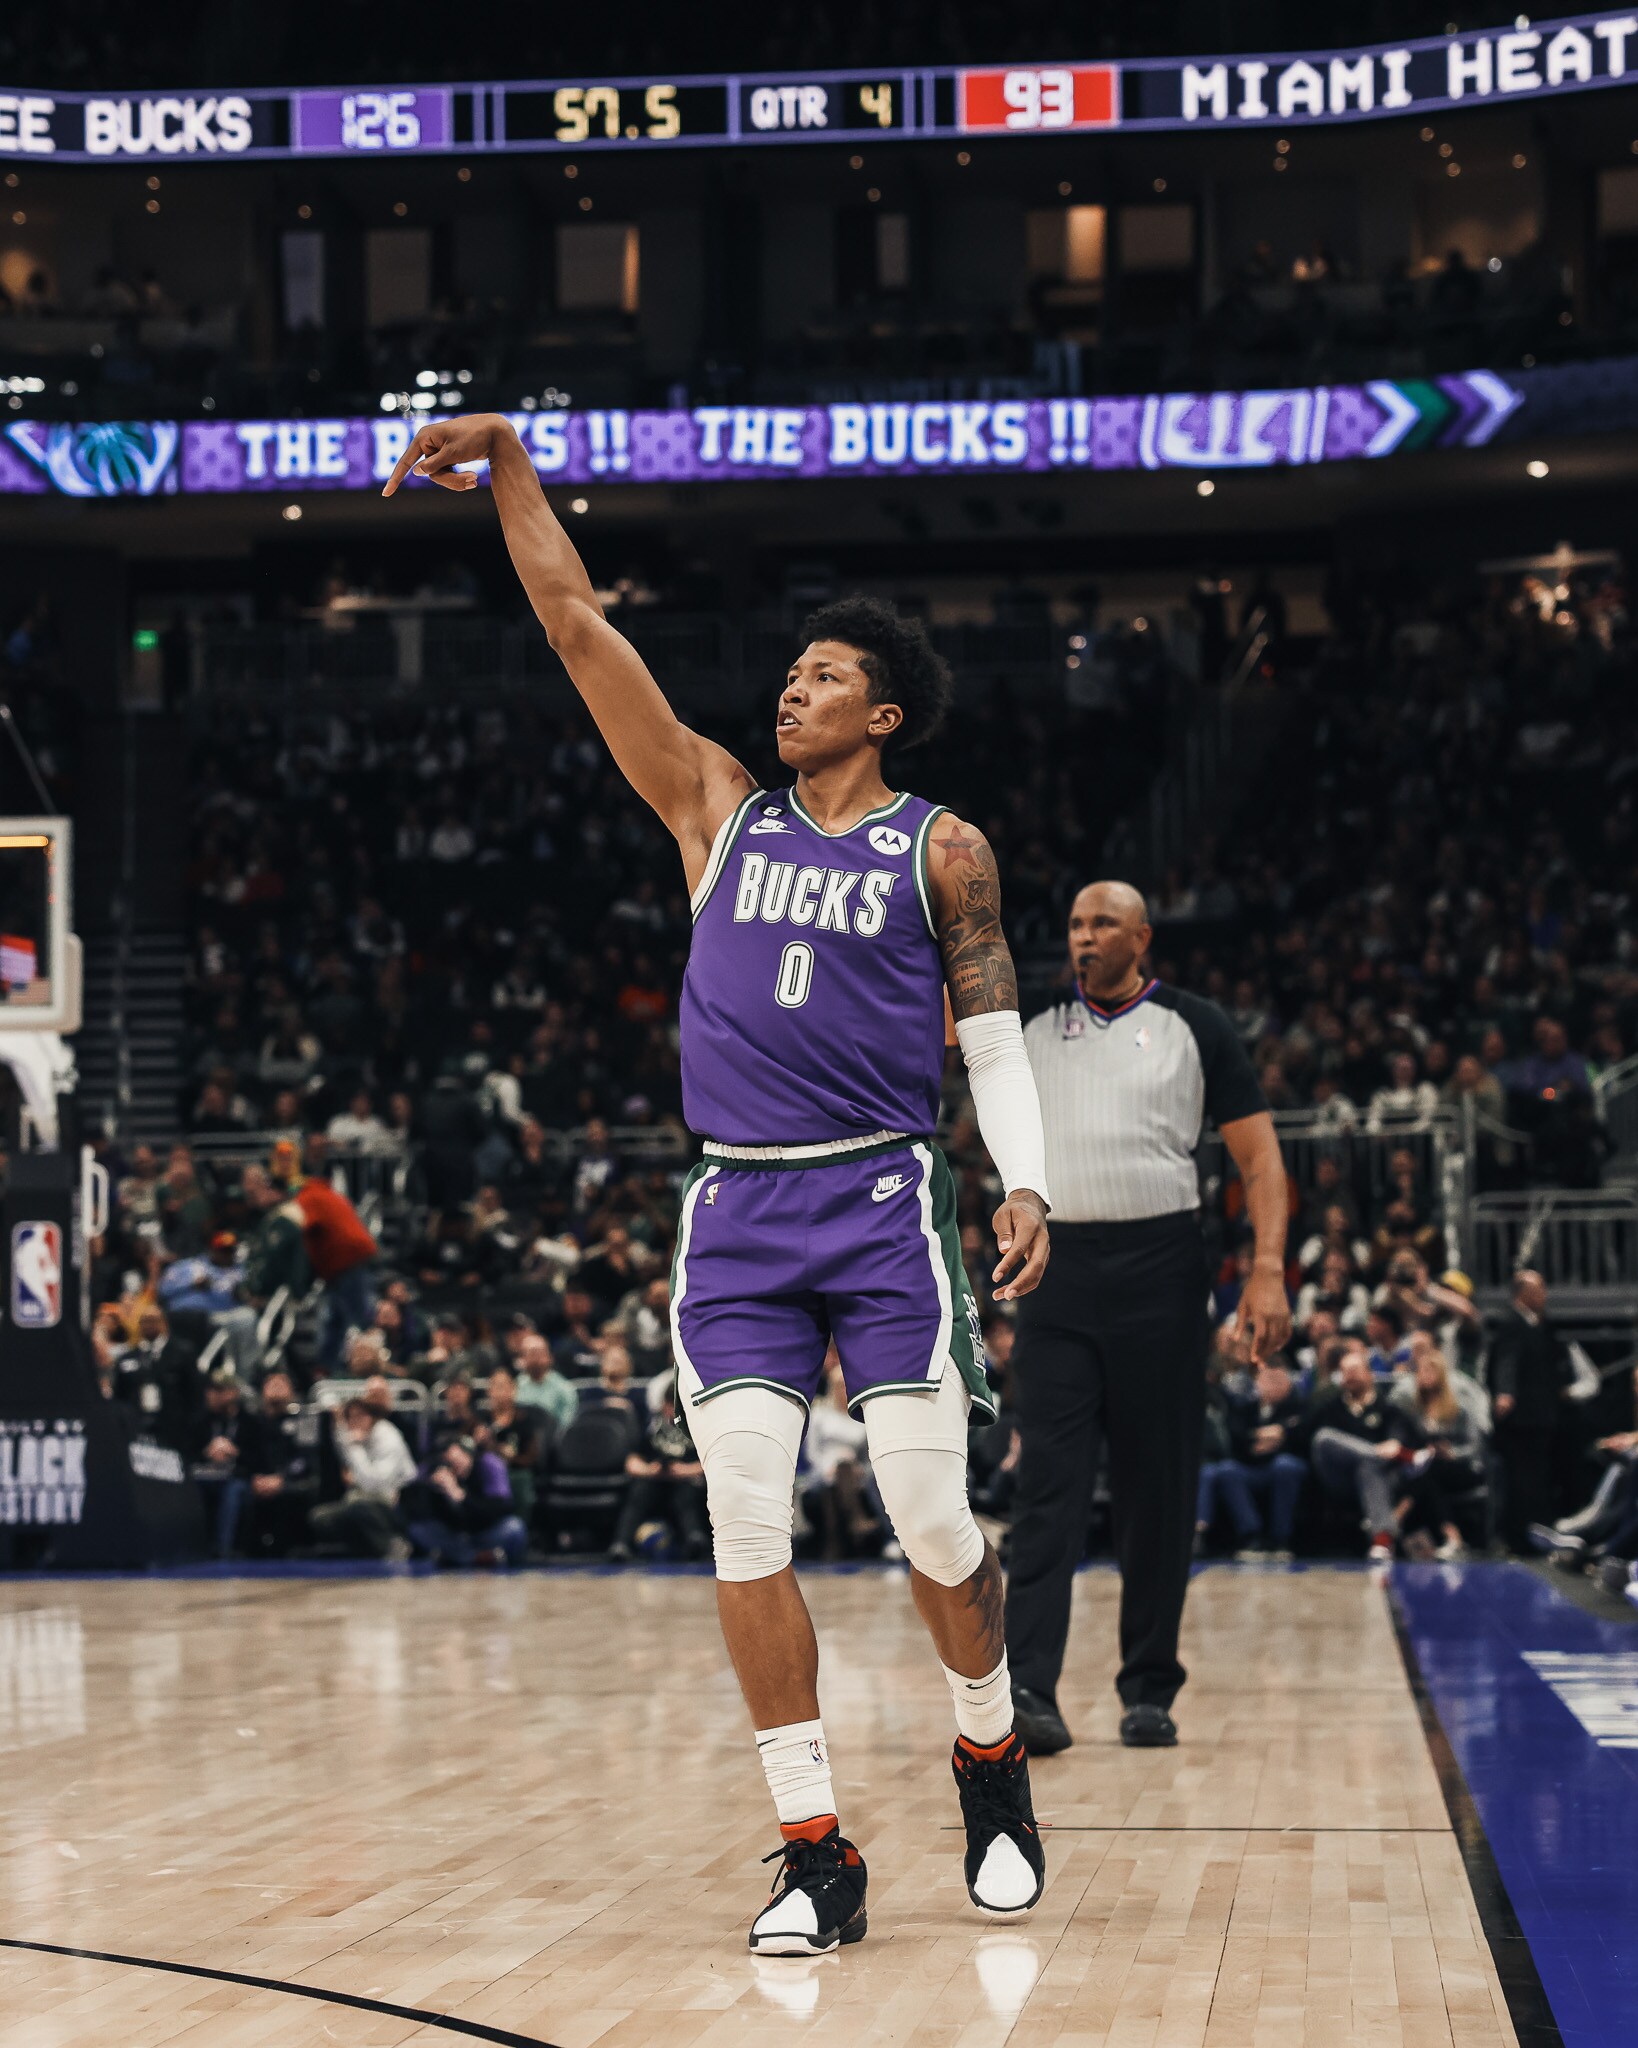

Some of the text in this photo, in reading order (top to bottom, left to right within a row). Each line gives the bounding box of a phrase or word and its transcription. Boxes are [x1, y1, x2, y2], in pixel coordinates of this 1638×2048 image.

[1181, 16, 1638, 122] MIAMI HEAT
[85, 96, 253, 155] BUCKS
[341, 92, 421, 150] 126
[554, 84, 681, 143] 57.5
[750, 82, 892, 130] QTR 4
[1003, 69, 1074, 130] 93
[237, 421, 348, 479] THE
[695, 406, 804, 465] THE
[828, 403, 1028, 465] BUCKS
[763, 806, 782, 816] 6
[733, 853, 901, 937] BUCKS
[774, 940, 815, 1009] 0
[877, 1174, 902, 1191] NIKE
